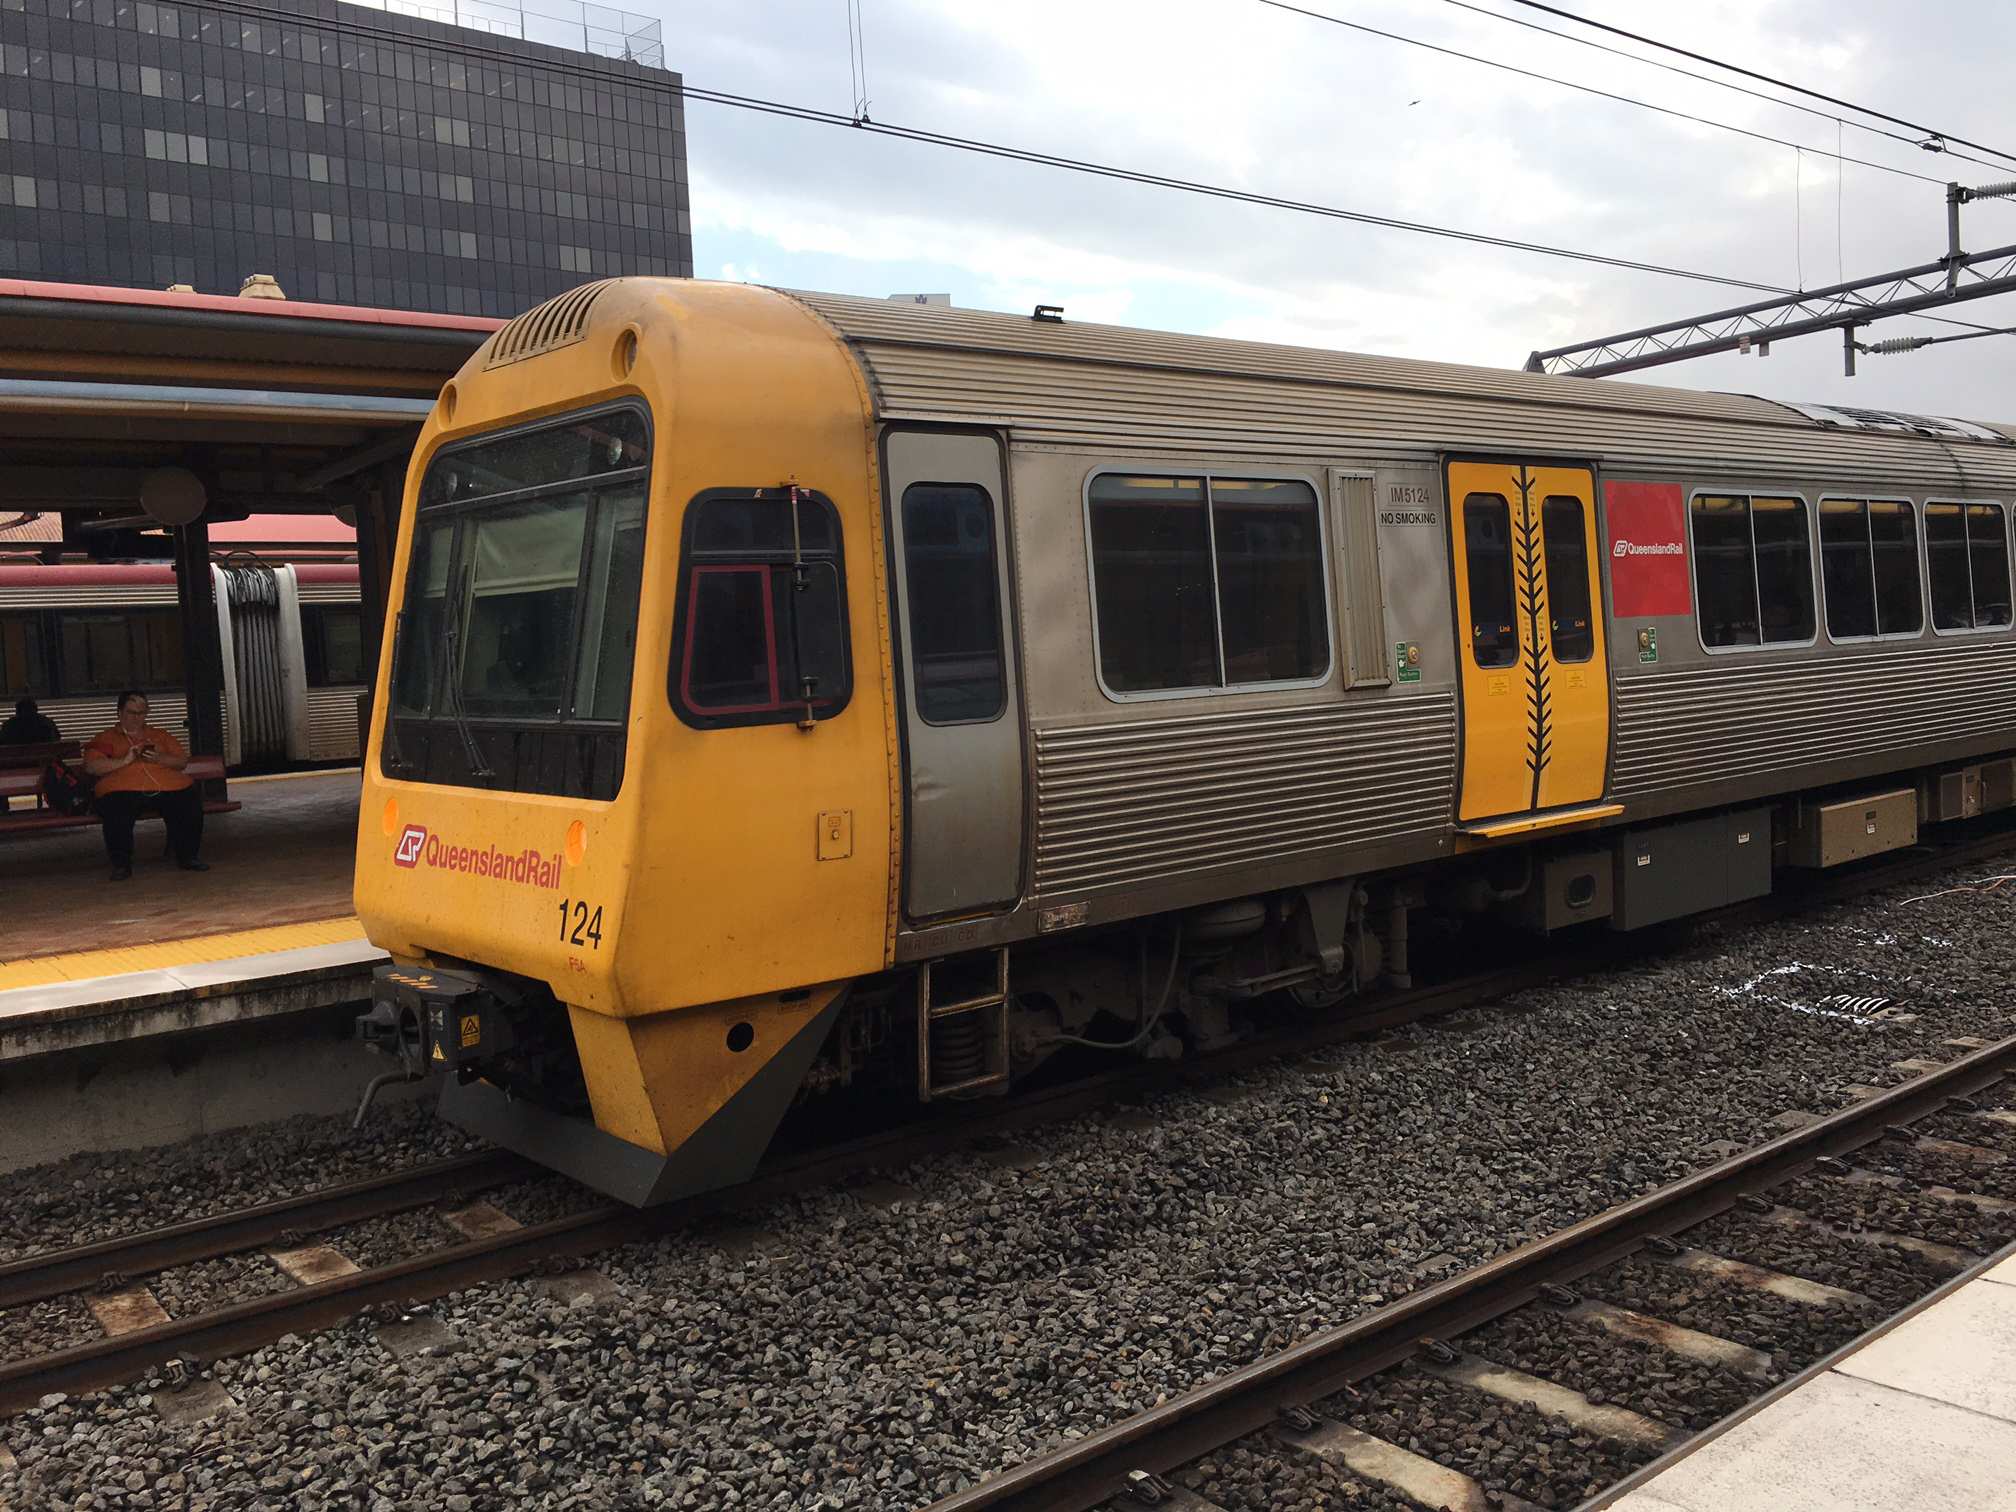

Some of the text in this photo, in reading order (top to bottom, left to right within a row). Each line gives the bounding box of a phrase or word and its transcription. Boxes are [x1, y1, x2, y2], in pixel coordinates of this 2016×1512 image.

[1390, 487, 1430, 503] IM5124
[1380, 512, 1436, 525] NO SMOKING
[1628, 542, 1684, 556] QueenslandRail
[426, 834, 562, 889] QueenslandRail
[559, 898, 602, 949] 124
